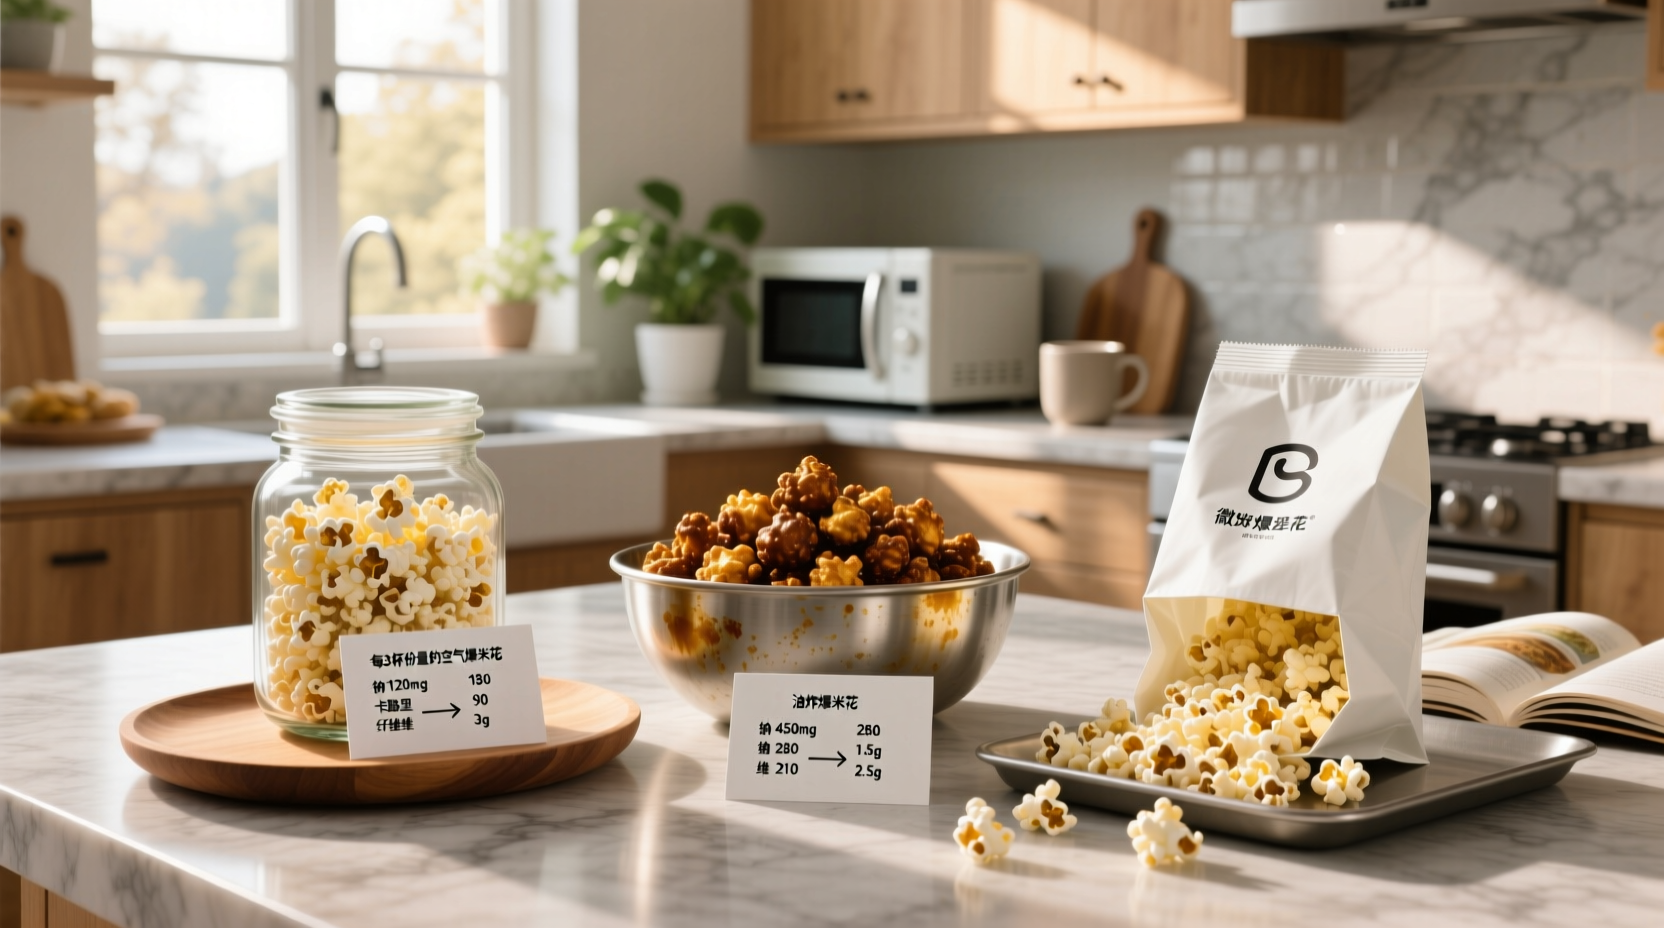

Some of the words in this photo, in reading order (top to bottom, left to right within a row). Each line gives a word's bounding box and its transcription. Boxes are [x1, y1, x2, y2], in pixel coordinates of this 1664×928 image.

[473, 694, 488, 706] 90
[474, 714, 489, 728] 3g
[775, 723, 817, 738] 450mg
[857, 744, 881, 759] 1.5g
[775, 761, 798, 775] 210
[855, 765, 881, 781] 2.5g
